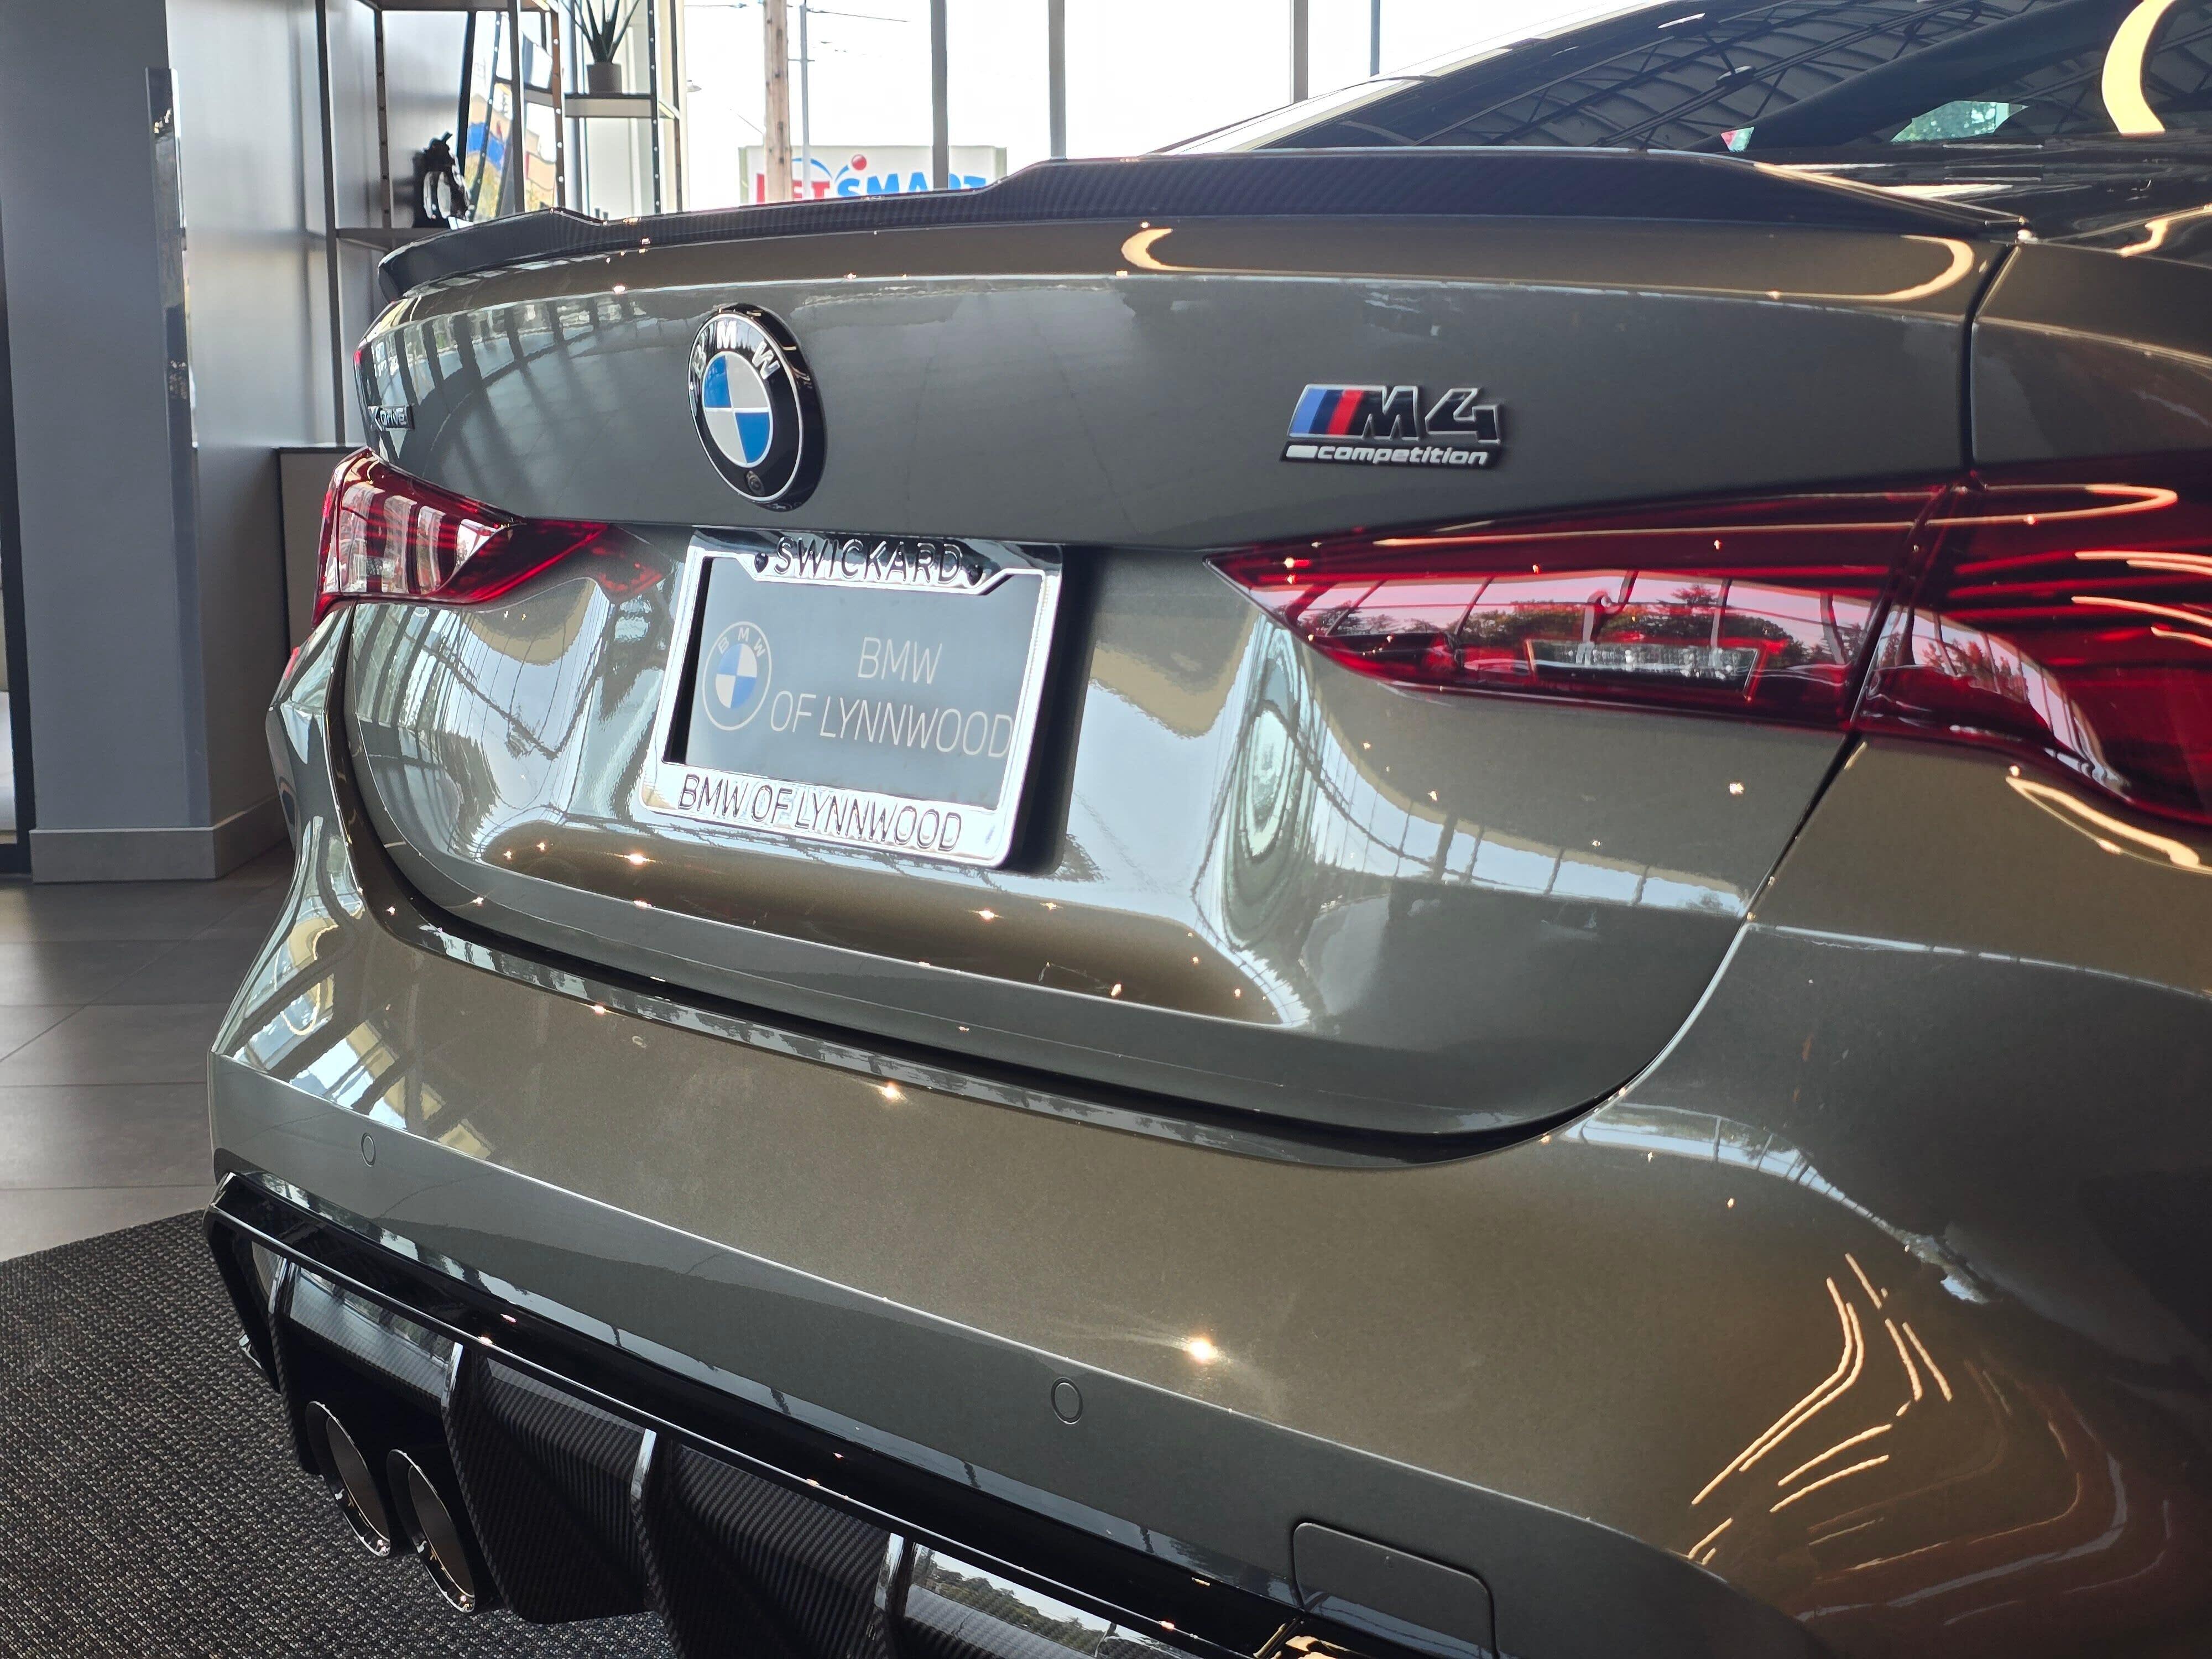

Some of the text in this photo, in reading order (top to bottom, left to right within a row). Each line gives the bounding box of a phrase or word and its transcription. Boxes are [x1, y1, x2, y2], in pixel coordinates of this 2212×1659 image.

[691, 321, 780, 380] BMW
[1345, 385, 1501, 444] M4
[1317, 445, 1489, 466] competition
[774, 535, 963, 585] SWICKARD
[718, 627, 766, 658] BMW
[858, 637, 942, 685] BMW
[770, 690, 1013, 758] OF LYNNWOOD
[678, 773, 962, 852] BMW OF LYNNWOOD
